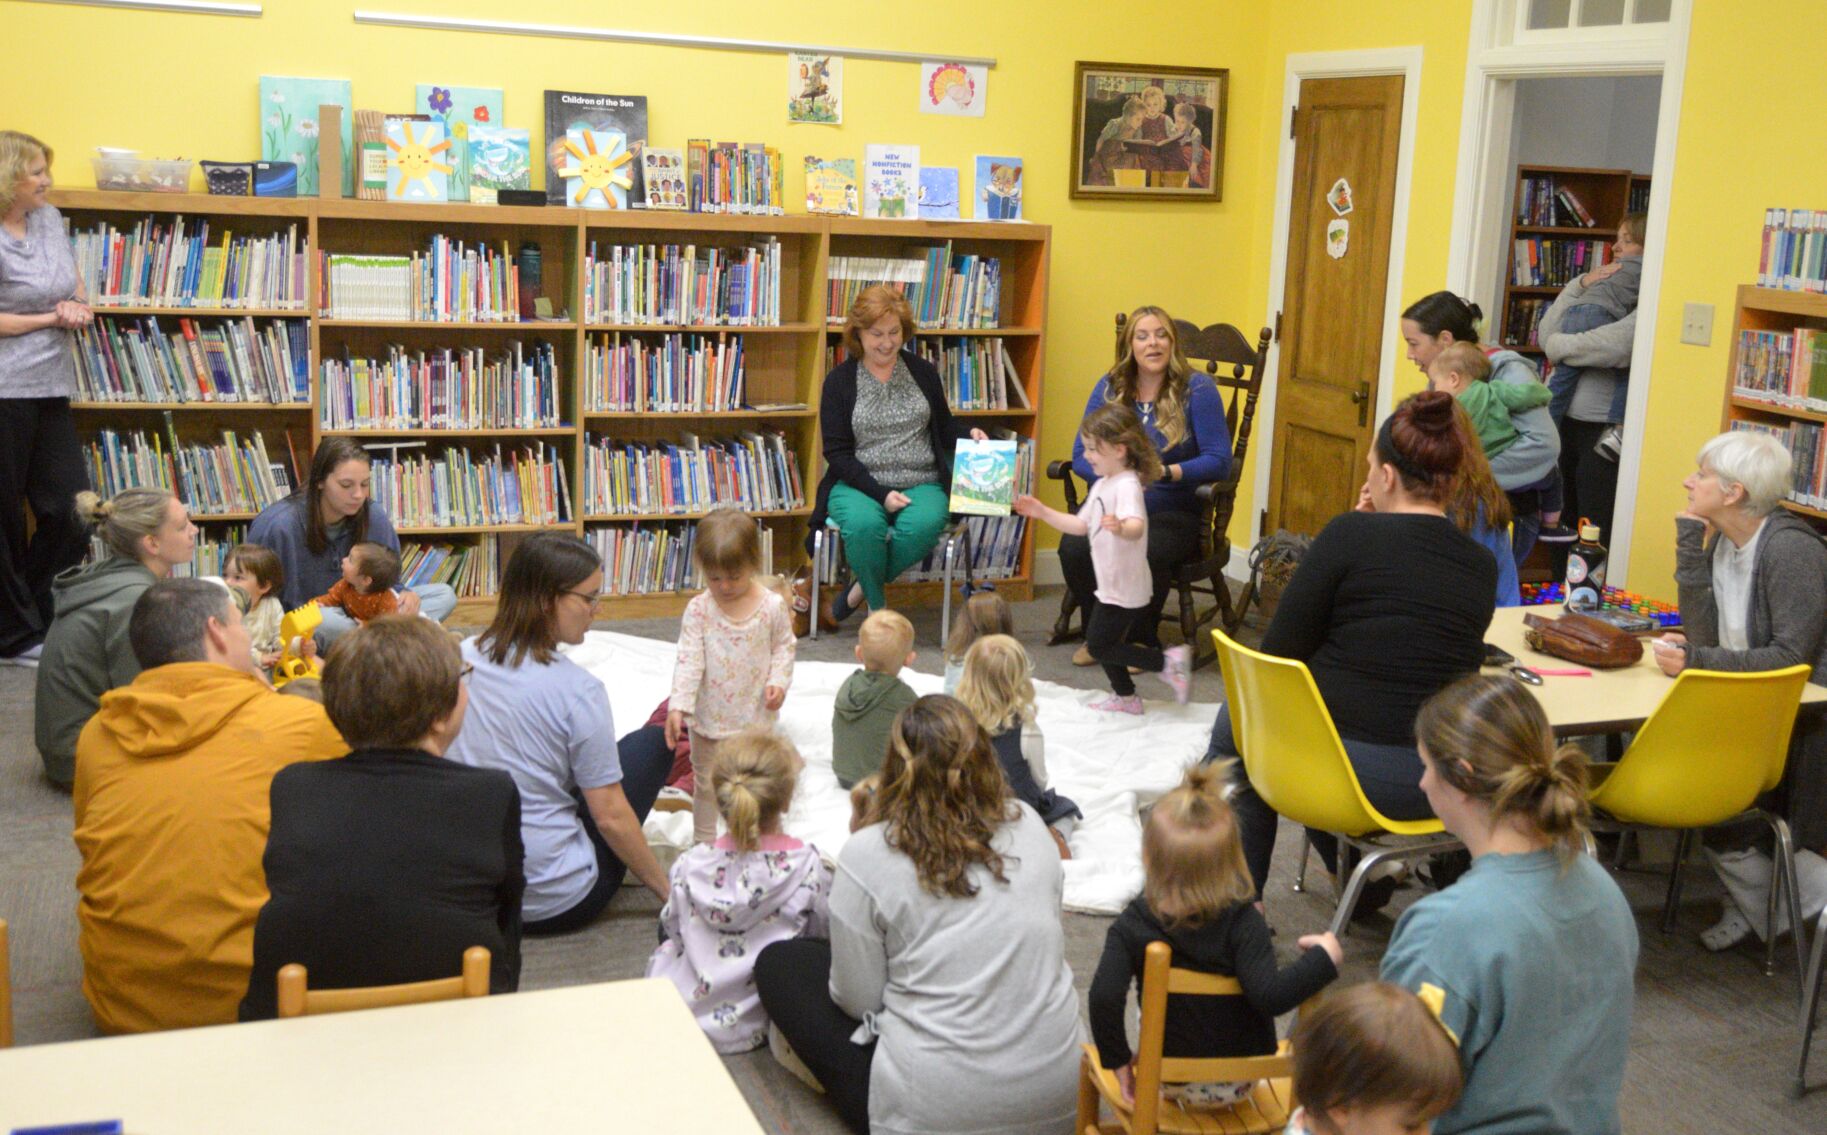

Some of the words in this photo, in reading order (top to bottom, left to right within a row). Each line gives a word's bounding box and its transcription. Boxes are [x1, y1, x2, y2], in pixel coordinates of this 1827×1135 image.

[562, 95, 594, 106] Children
[596, 98, 606, 106] of
[606, 99, 618, 107] the
[620, 100, 634, 108] Sun
